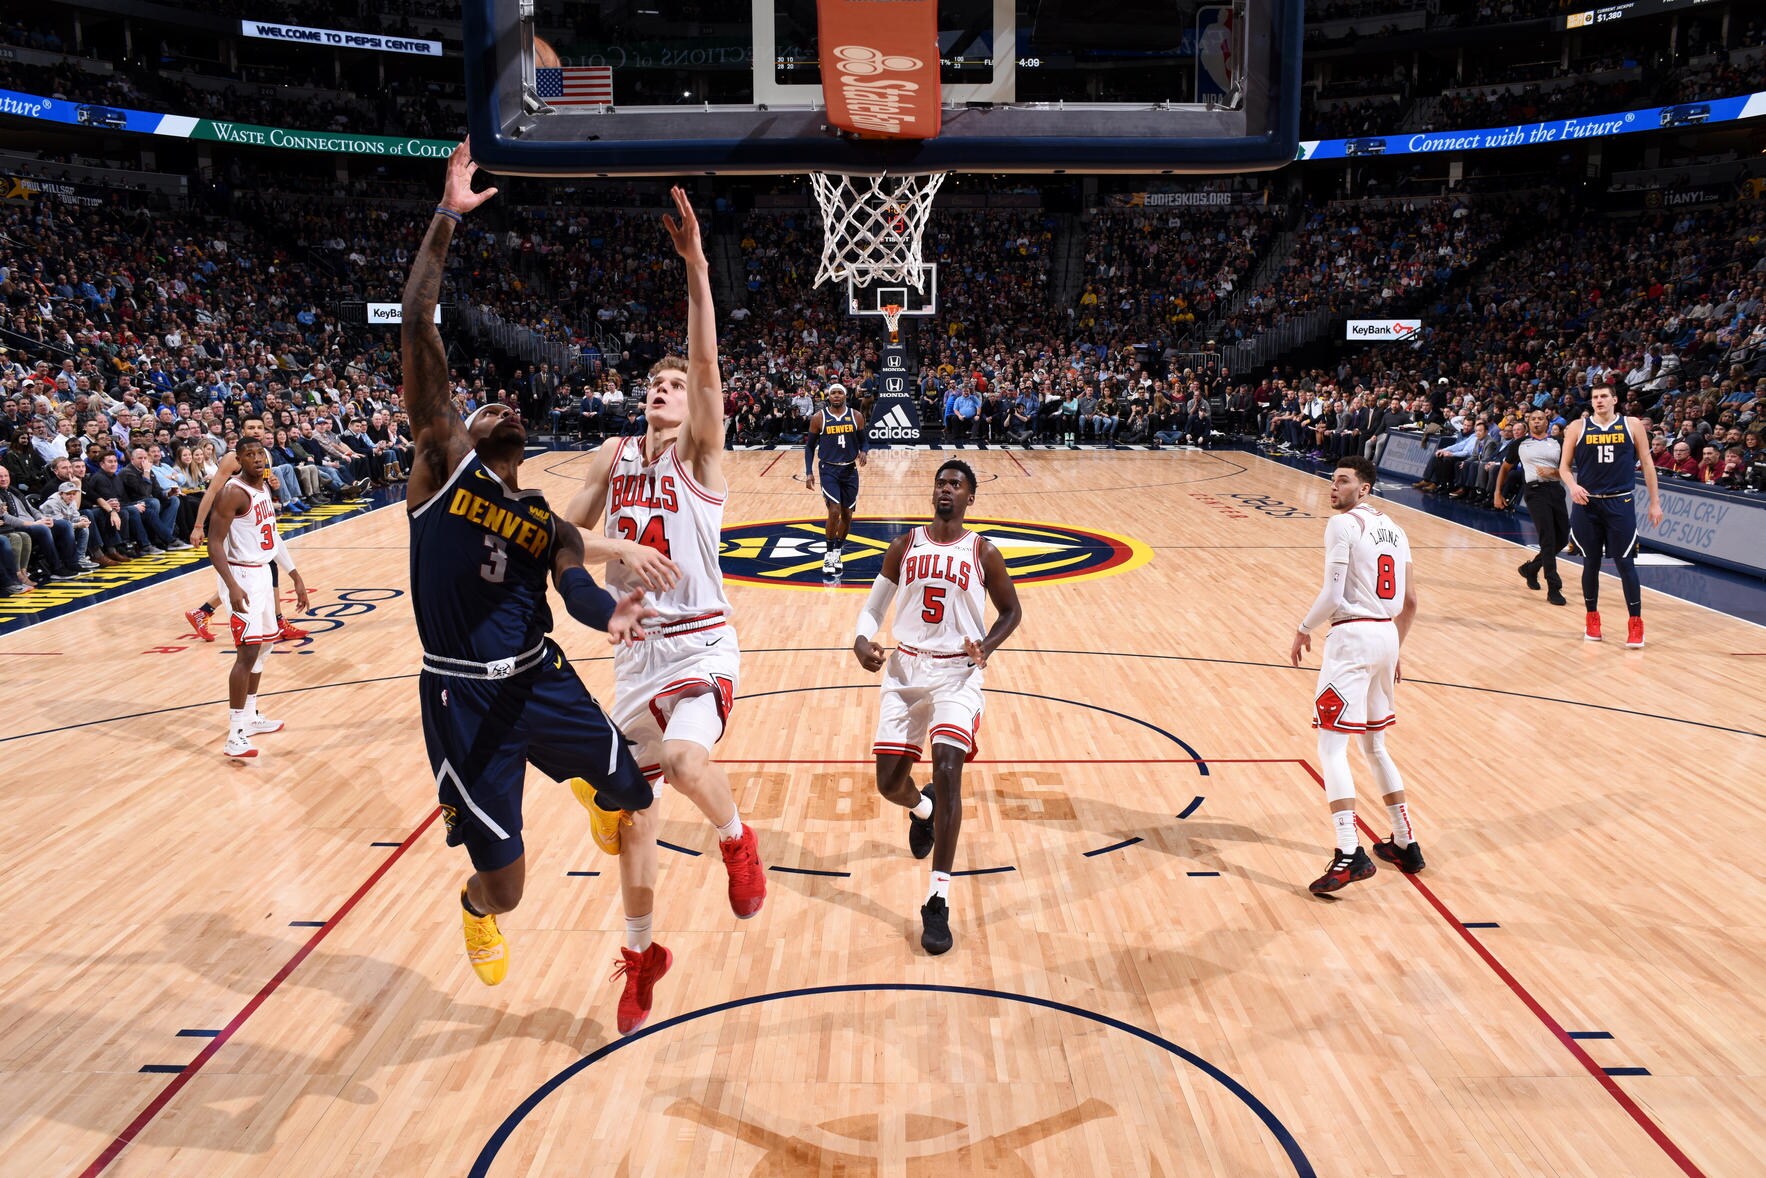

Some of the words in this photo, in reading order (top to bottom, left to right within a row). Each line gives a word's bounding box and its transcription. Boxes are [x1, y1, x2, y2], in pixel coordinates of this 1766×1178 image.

[1596, 11, 1623, 22] $1,380
[256, 24, 321, 41] WELCOME
[324, 32, 342, 44] TO
[345, 34, 382, 48] PEPSI
[385, 39, 431, 53] CENTER
[1019, 58, 1040, 67] 4:09
[1409, 131, 1480, 153] Connect
[1485, 125, 1526, 148] with
[1529, 122, 1556, 146] the
[389, 142, 404, 155] of
[407, 139, 456, 158] COLO
[373, 308, 403, 320] KeyBa
[1352, 325, 1392, 336] KeyBank
[825, 423, 854, 435] DENVER
[868, 426, 920, 439] adidas
[1585, 433, 1625, 445] DENVER
[837, 434, 846, 449] 4
[1597, 444, 1615, 464] 15
[611, 473, 679, 515] BULLS
[254, 499, 275, 526] BUL
[1694, 502, 1730, 525] CR-V
[448, 487, 550, 560] DENVER
[1658, 518, 1681, 539] OF
[1678, 523, 1716, 549] SUVS
[1370, 528, 1400, 548] LAVINE
[480, 533, 508, 583] 3
[905, 553, 972, 592] BULLS
[1376, 553, 1397, 600] 8
[921, 586, 947, 625] 5
